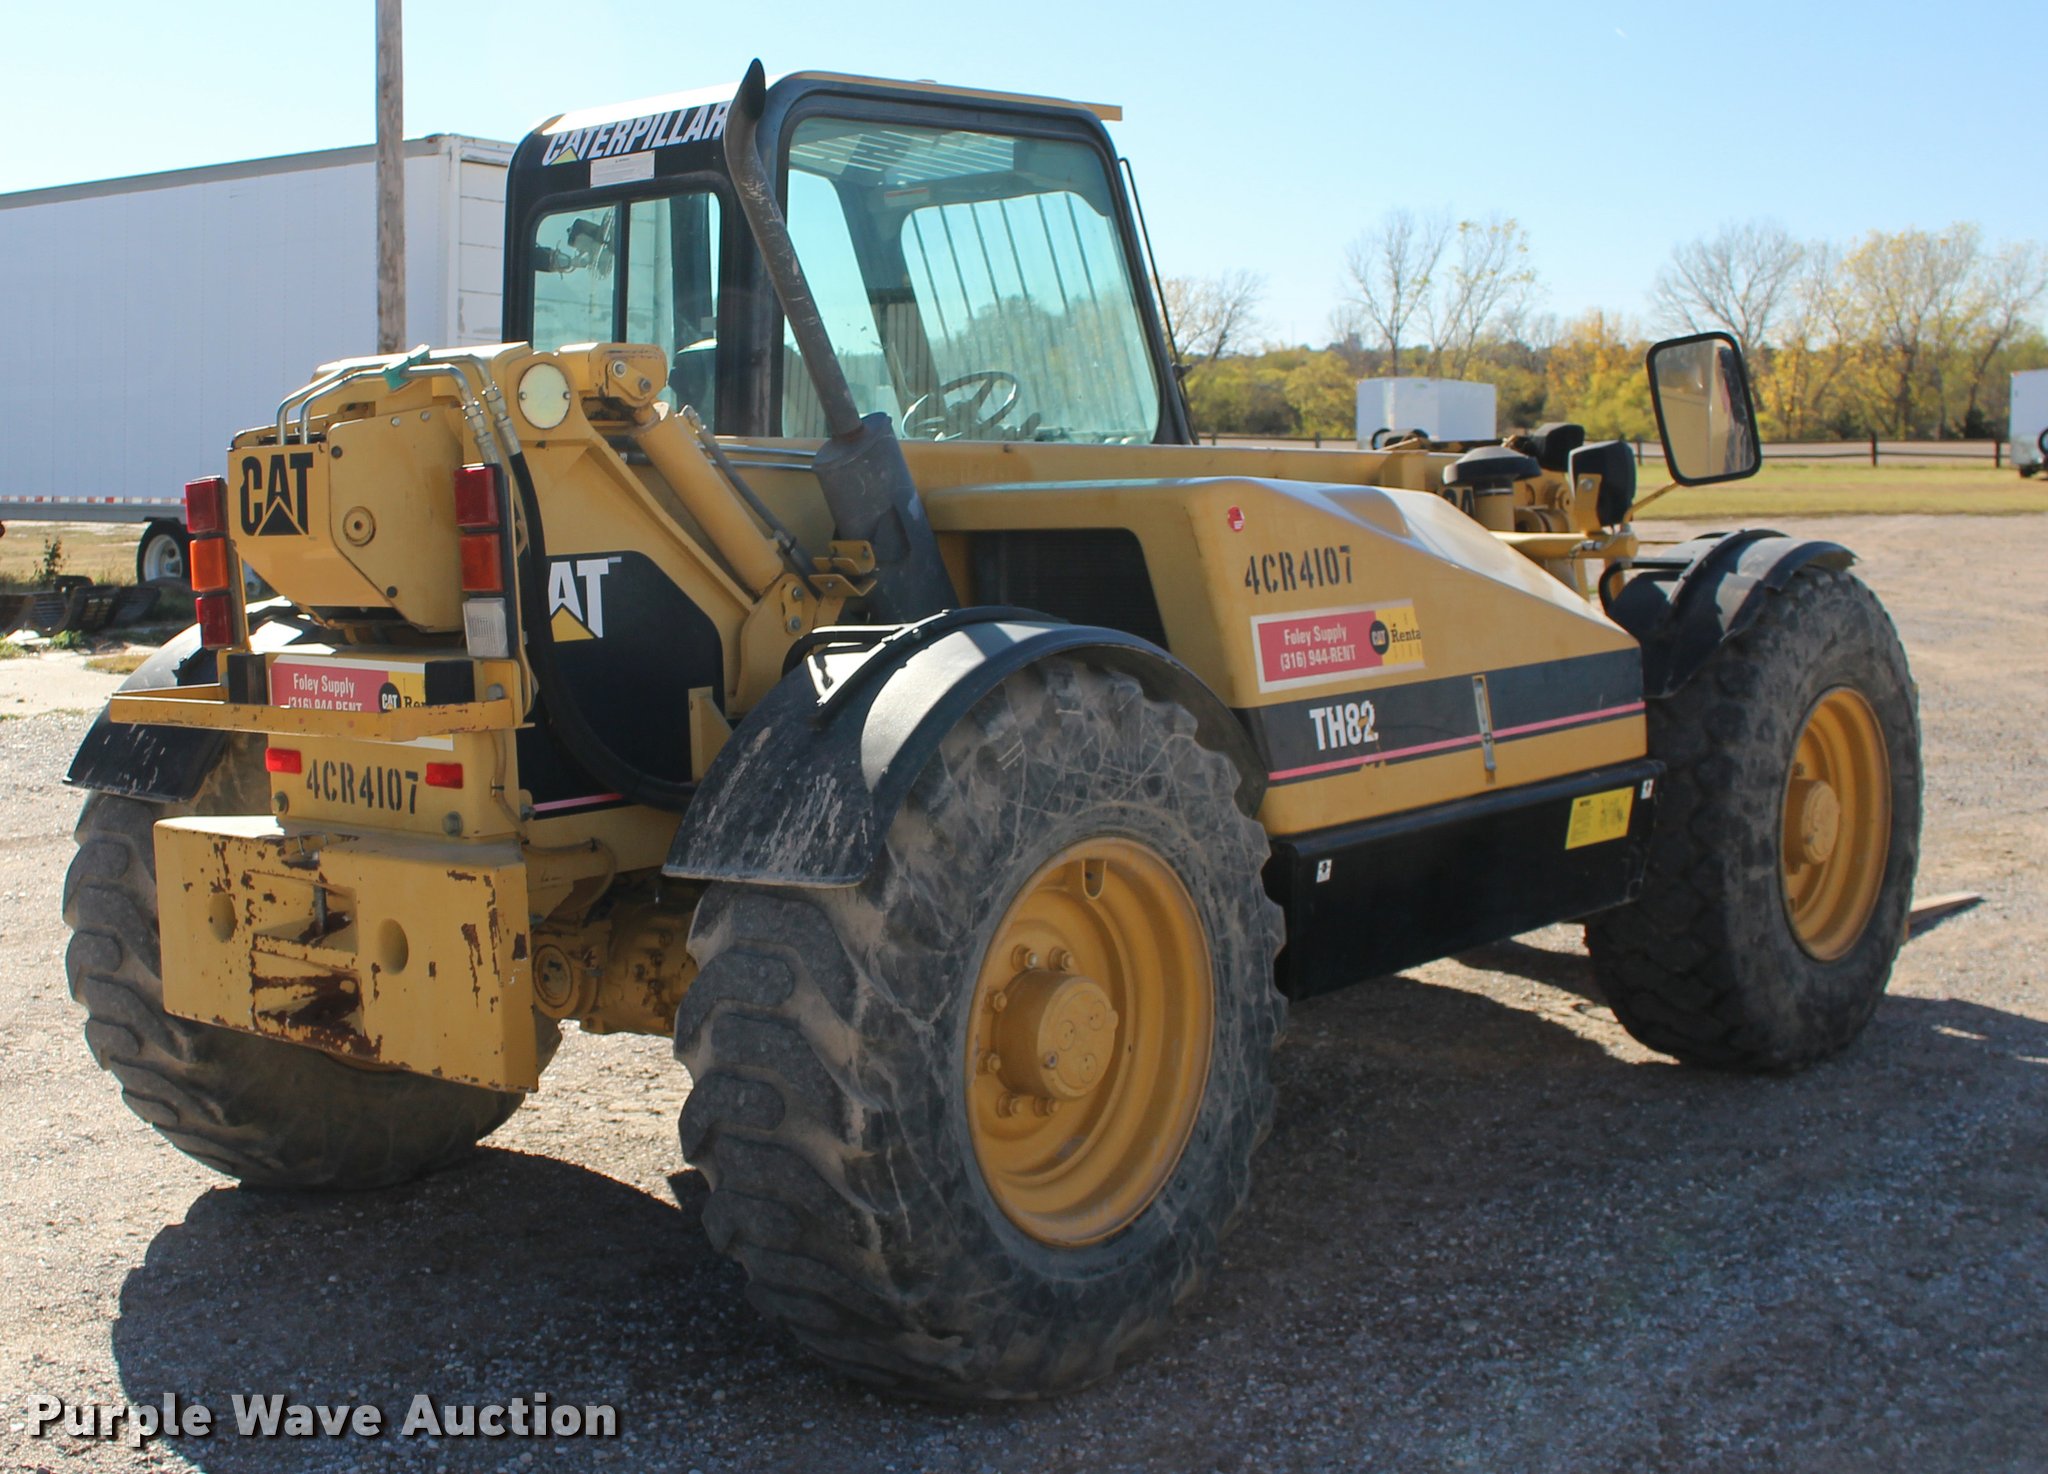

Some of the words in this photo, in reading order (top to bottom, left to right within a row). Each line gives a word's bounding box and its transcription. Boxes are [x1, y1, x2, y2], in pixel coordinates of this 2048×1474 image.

[541, 100, 731, 166] CATERPILLAR
[240, 452, 314, 535] CAT
[1244, 545, 1353, 595] 4CR4107
[547, 558, 610, 639] AT
[1280, 651, 1307, 672] (316)
[1308, 644, 1356, 666] 944-RENT
[1284, 628, 1311, 646] Foley
[1313, 623, 1347, 644] Supply
[293, 673, 318, 695] Foley
[321, 675, 355, 698] Supply
[381, 693, 398, 710] CAT
[1309, 700, 1379, 751] TH82
[306, 759, 419, 814] 4CR4107
